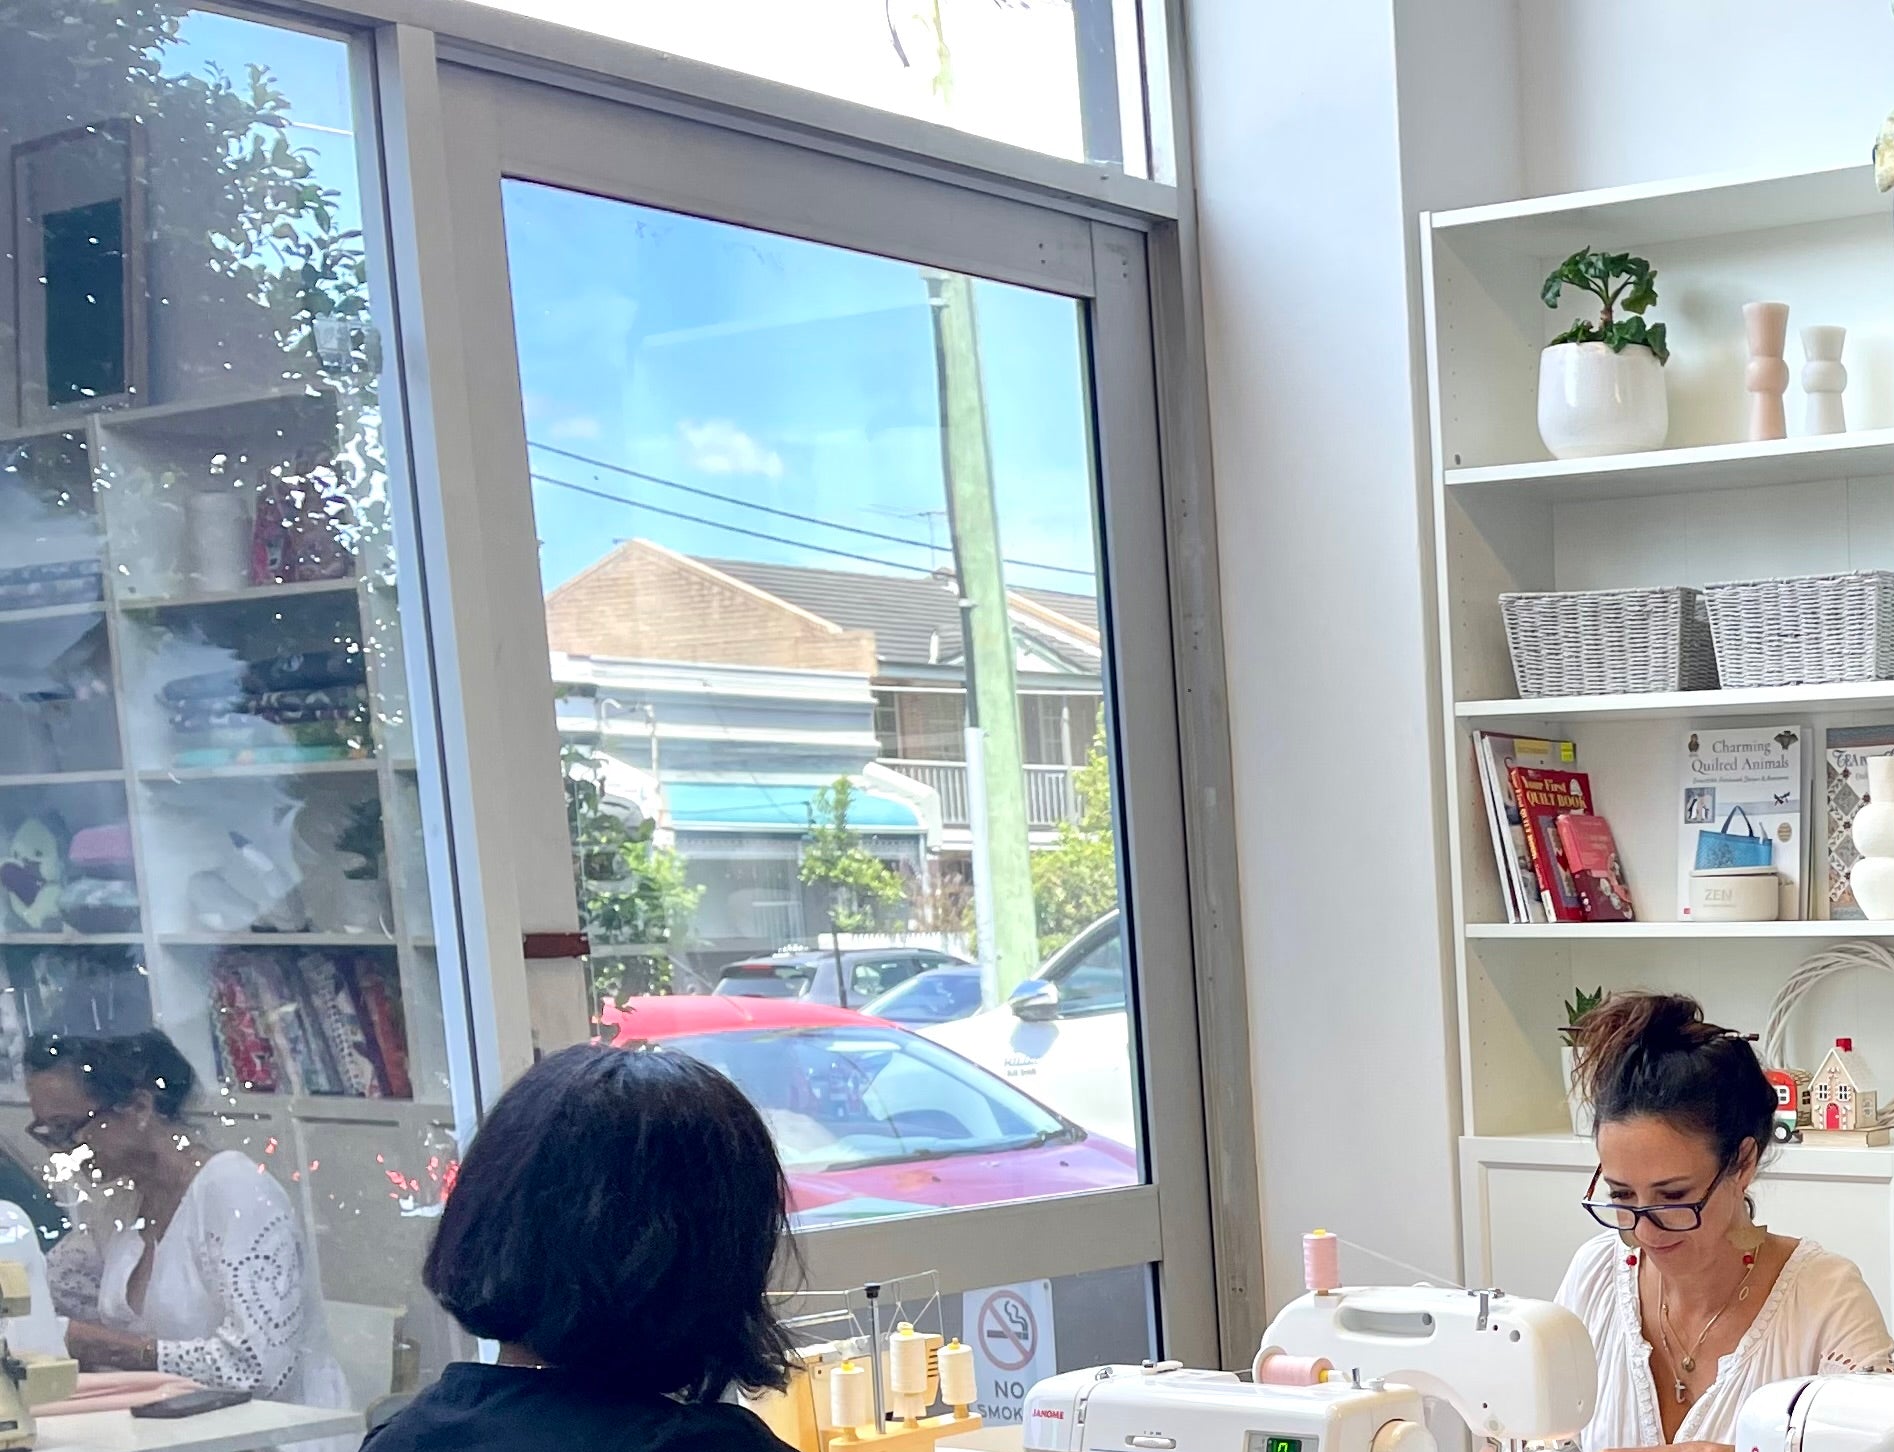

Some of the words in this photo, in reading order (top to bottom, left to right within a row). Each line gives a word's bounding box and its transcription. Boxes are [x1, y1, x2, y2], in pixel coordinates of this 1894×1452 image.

[1712, 739, 1772, 756] Charming
[1691, 756, 1738, 775] Quilted
[1741, 754, 1789, 770] Animals
[1544, 778, 1567, 793] First
[1526, 790, 1556, 807] QUILT
[1556, 794, 1587, 809] BOOK
[1704, 888, 1733, 901] ZEN
[994, 1380, 1024, 1399] NO
[977, 1404, 1023, 1421] SMOK
[1032, 1408, 1065, 1420] JANOME
